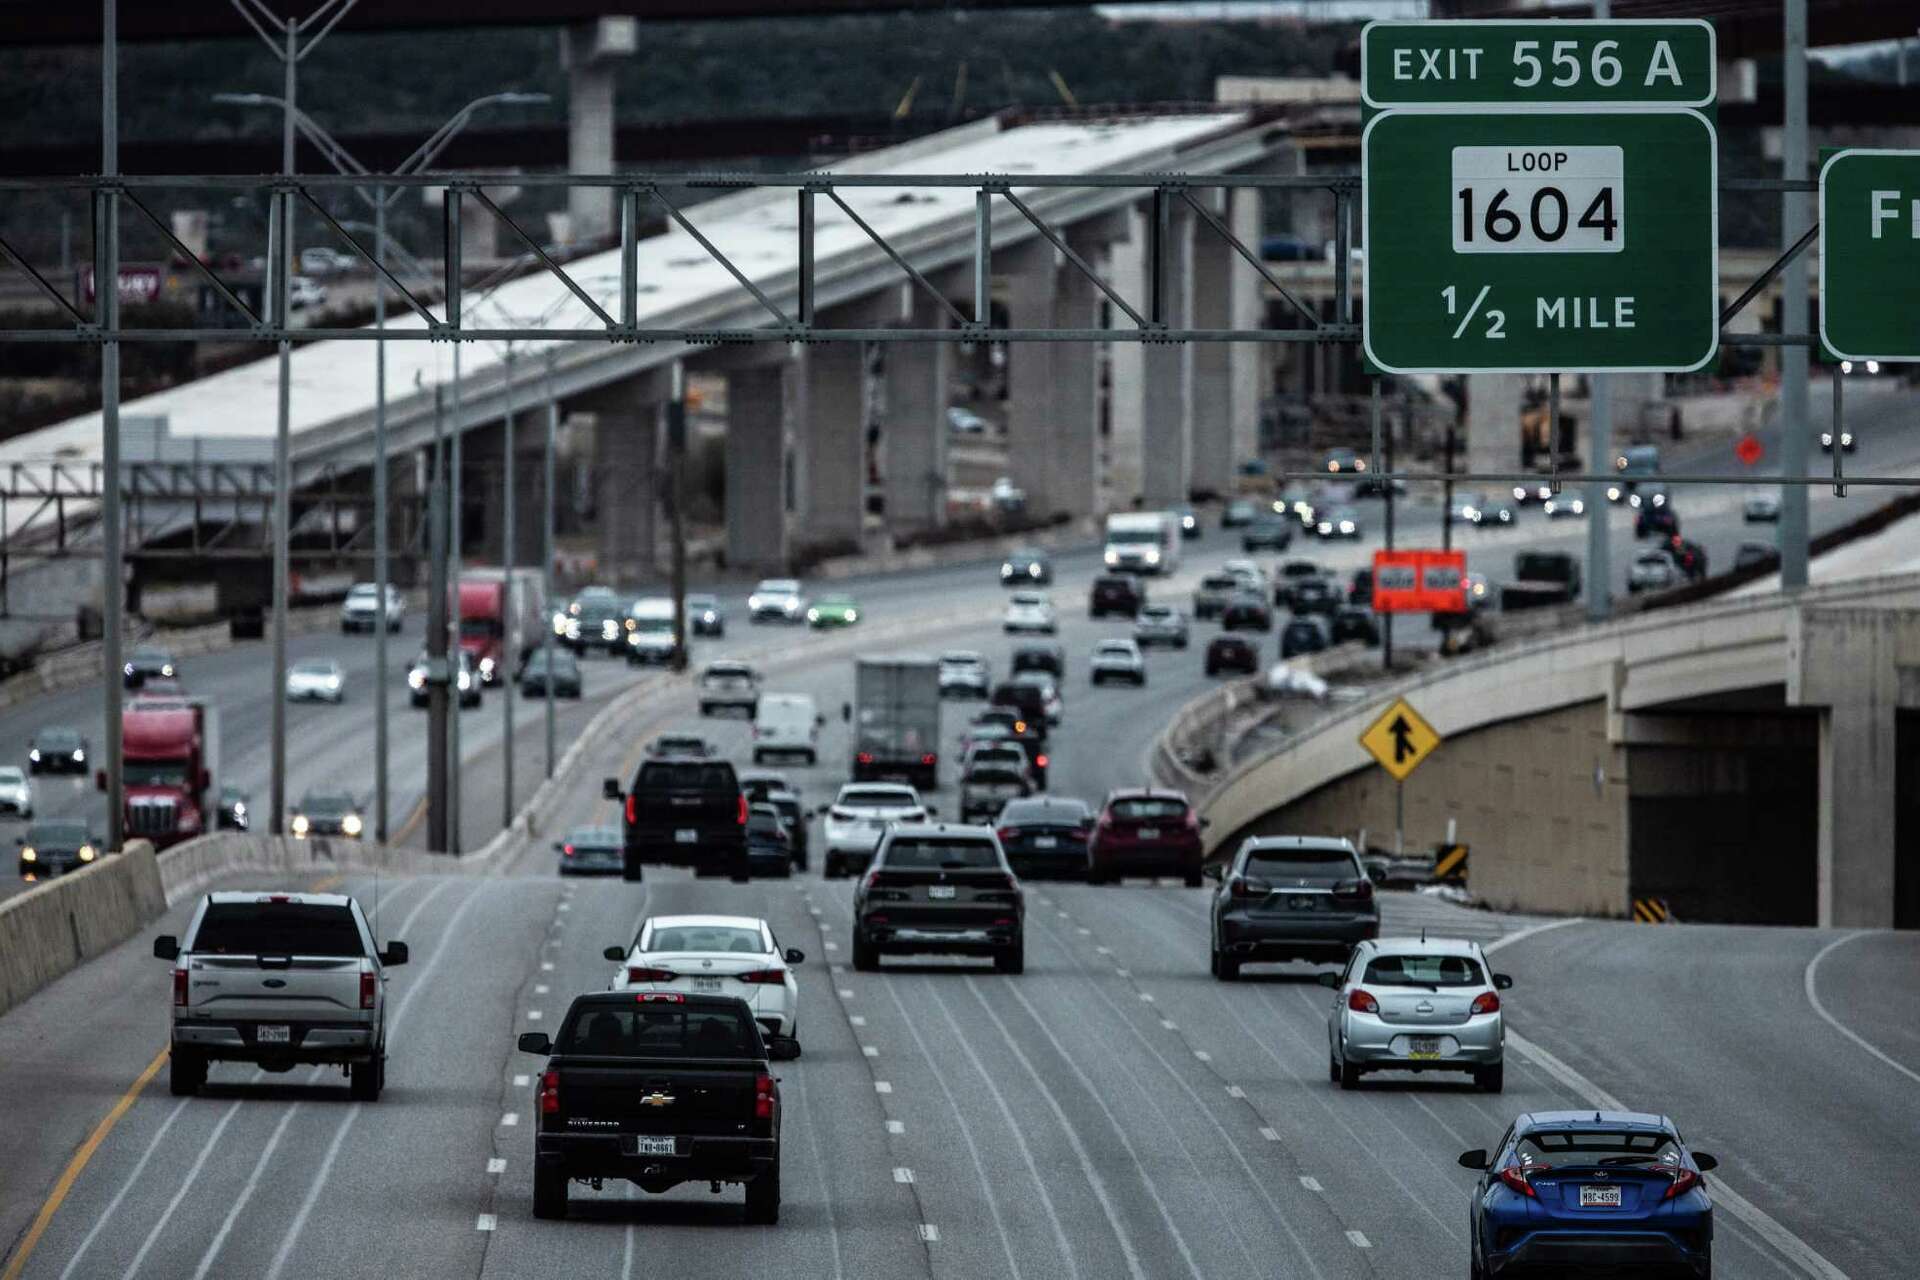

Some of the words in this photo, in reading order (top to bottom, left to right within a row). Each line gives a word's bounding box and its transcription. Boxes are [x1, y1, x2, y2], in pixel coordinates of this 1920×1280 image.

[1394, 48, 1484, 80] EXIT
[1512, 39, 1623, 87] 556
[1643, 40, 1684, 86] A
[1507, 152, 1568, 171] LOOP
[1458, 186, 1618, 242] 1604
[1536, 296, 1636, 328] MILE
